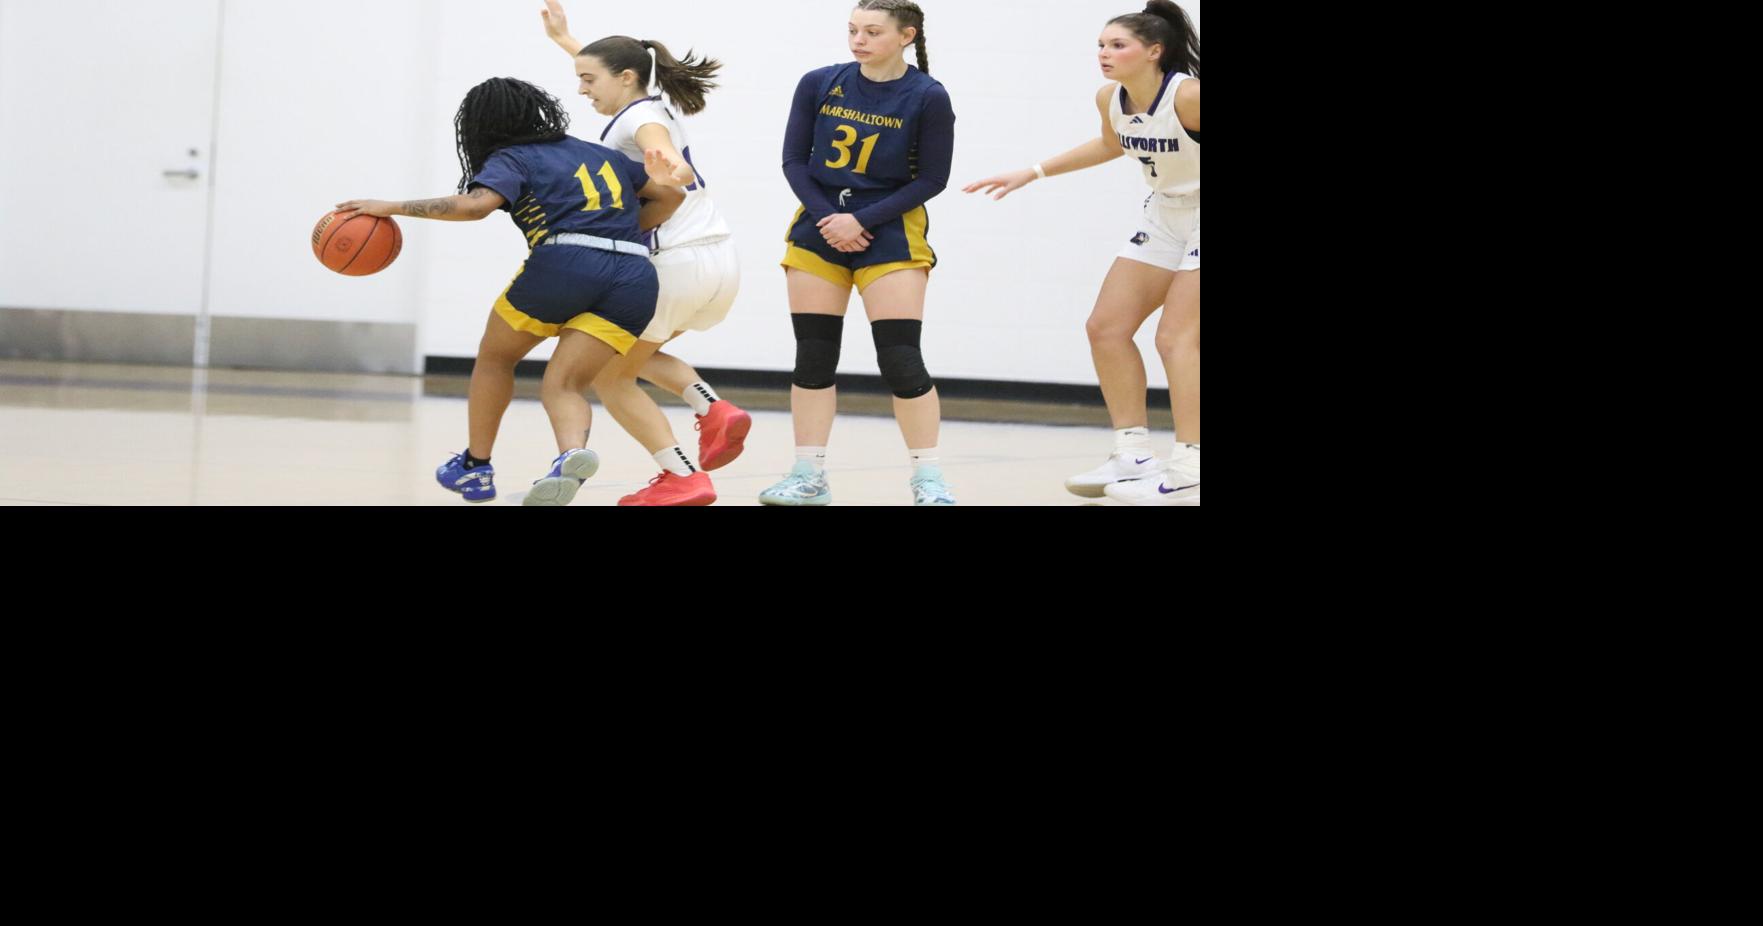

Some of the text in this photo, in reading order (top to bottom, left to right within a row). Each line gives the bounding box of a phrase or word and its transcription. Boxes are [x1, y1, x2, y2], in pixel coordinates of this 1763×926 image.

[819, 103, 904, 129] MARSHALLTOWN
[825, 124, 881, 175] 31
[574, 160, 625, 212] 11
